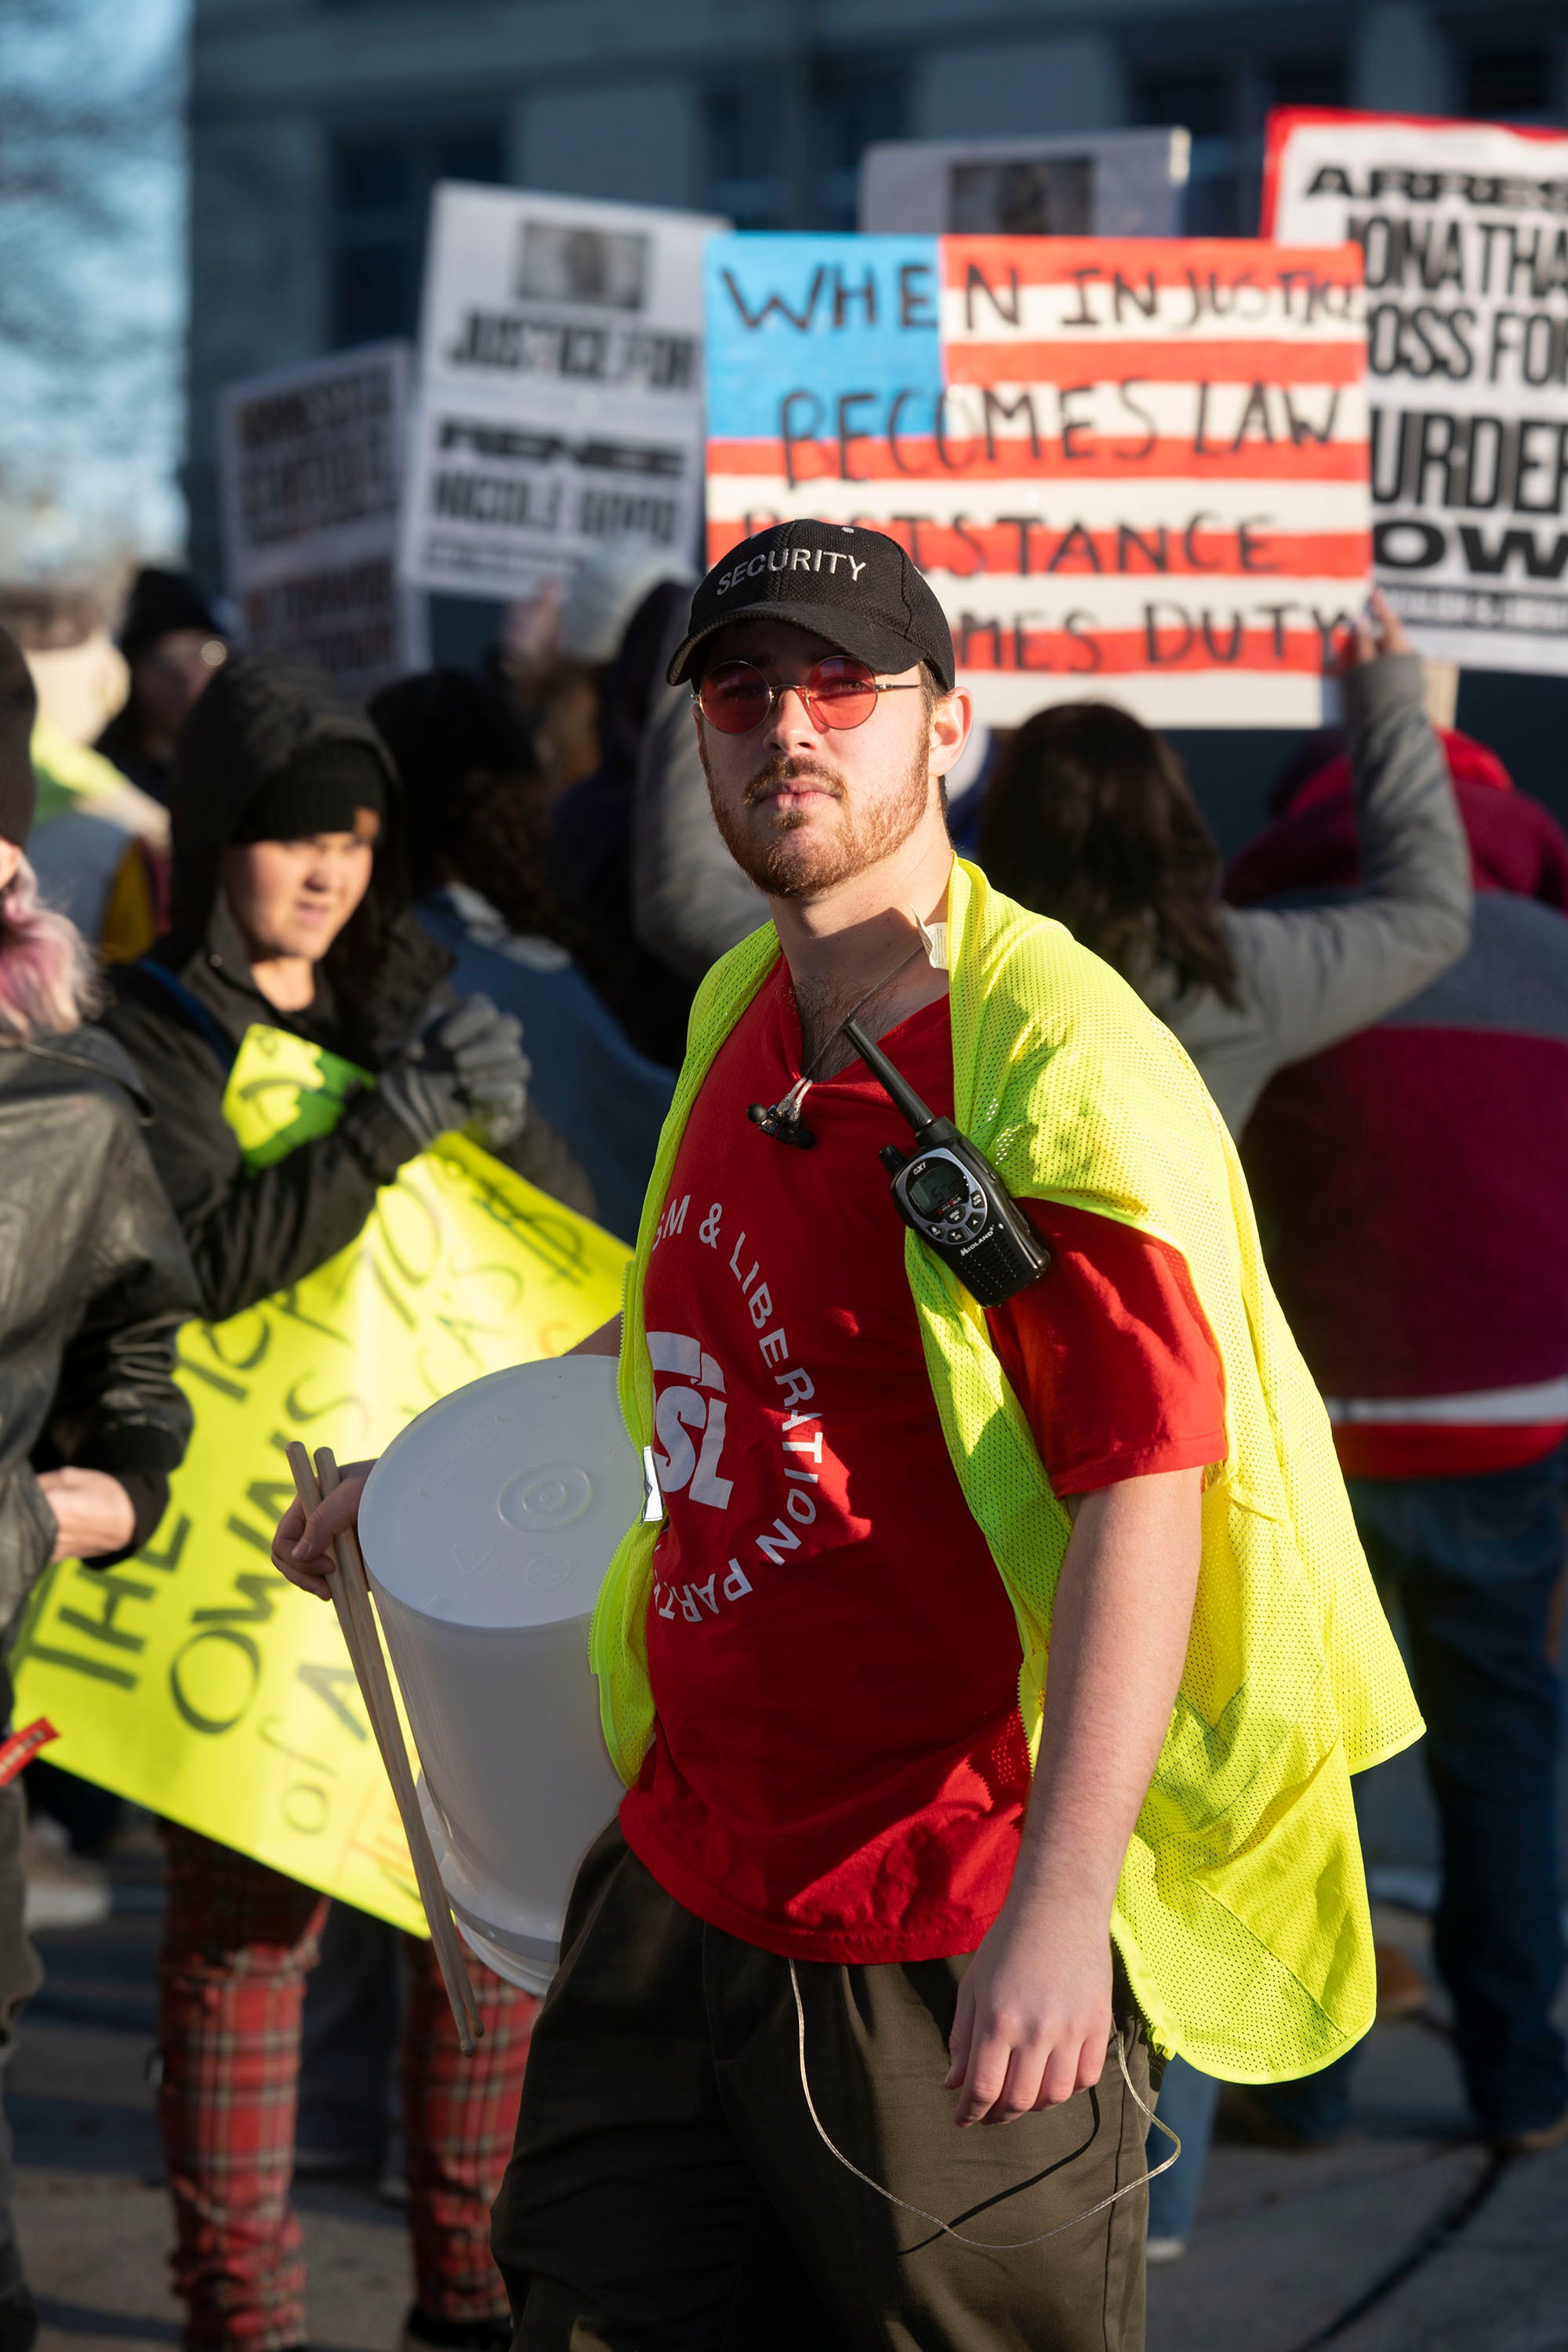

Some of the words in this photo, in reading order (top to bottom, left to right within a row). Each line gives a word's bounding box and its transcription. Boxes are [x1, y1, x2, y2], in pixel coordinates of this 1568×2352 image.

[1348, 216, 1568, 296] ONATHA
[721, 260, 1021, 332] WHEN
[1368, 304, 1475, 380] OSS
[780, 379, 1157, 488] BECOMES
[1192, 382, 1342, 457] LAW
[1370, 408, 1568, 514] URDE
[716, 548, 866, 596] SECURITY
[743, 511, 1279, 579] ISTANCE
[1143, 600, 1350, 665] DUTY
[913, 1161, 927, 1175] GXT
[699, 1203, 722, 1250] &
[960, 1231, 993, 1256] MIDLAND
[729, 1232, 824, 1566] LIBERATION
[652, 1385, 735, 1510] SL
[654, 1558, 753, 1623] PART
